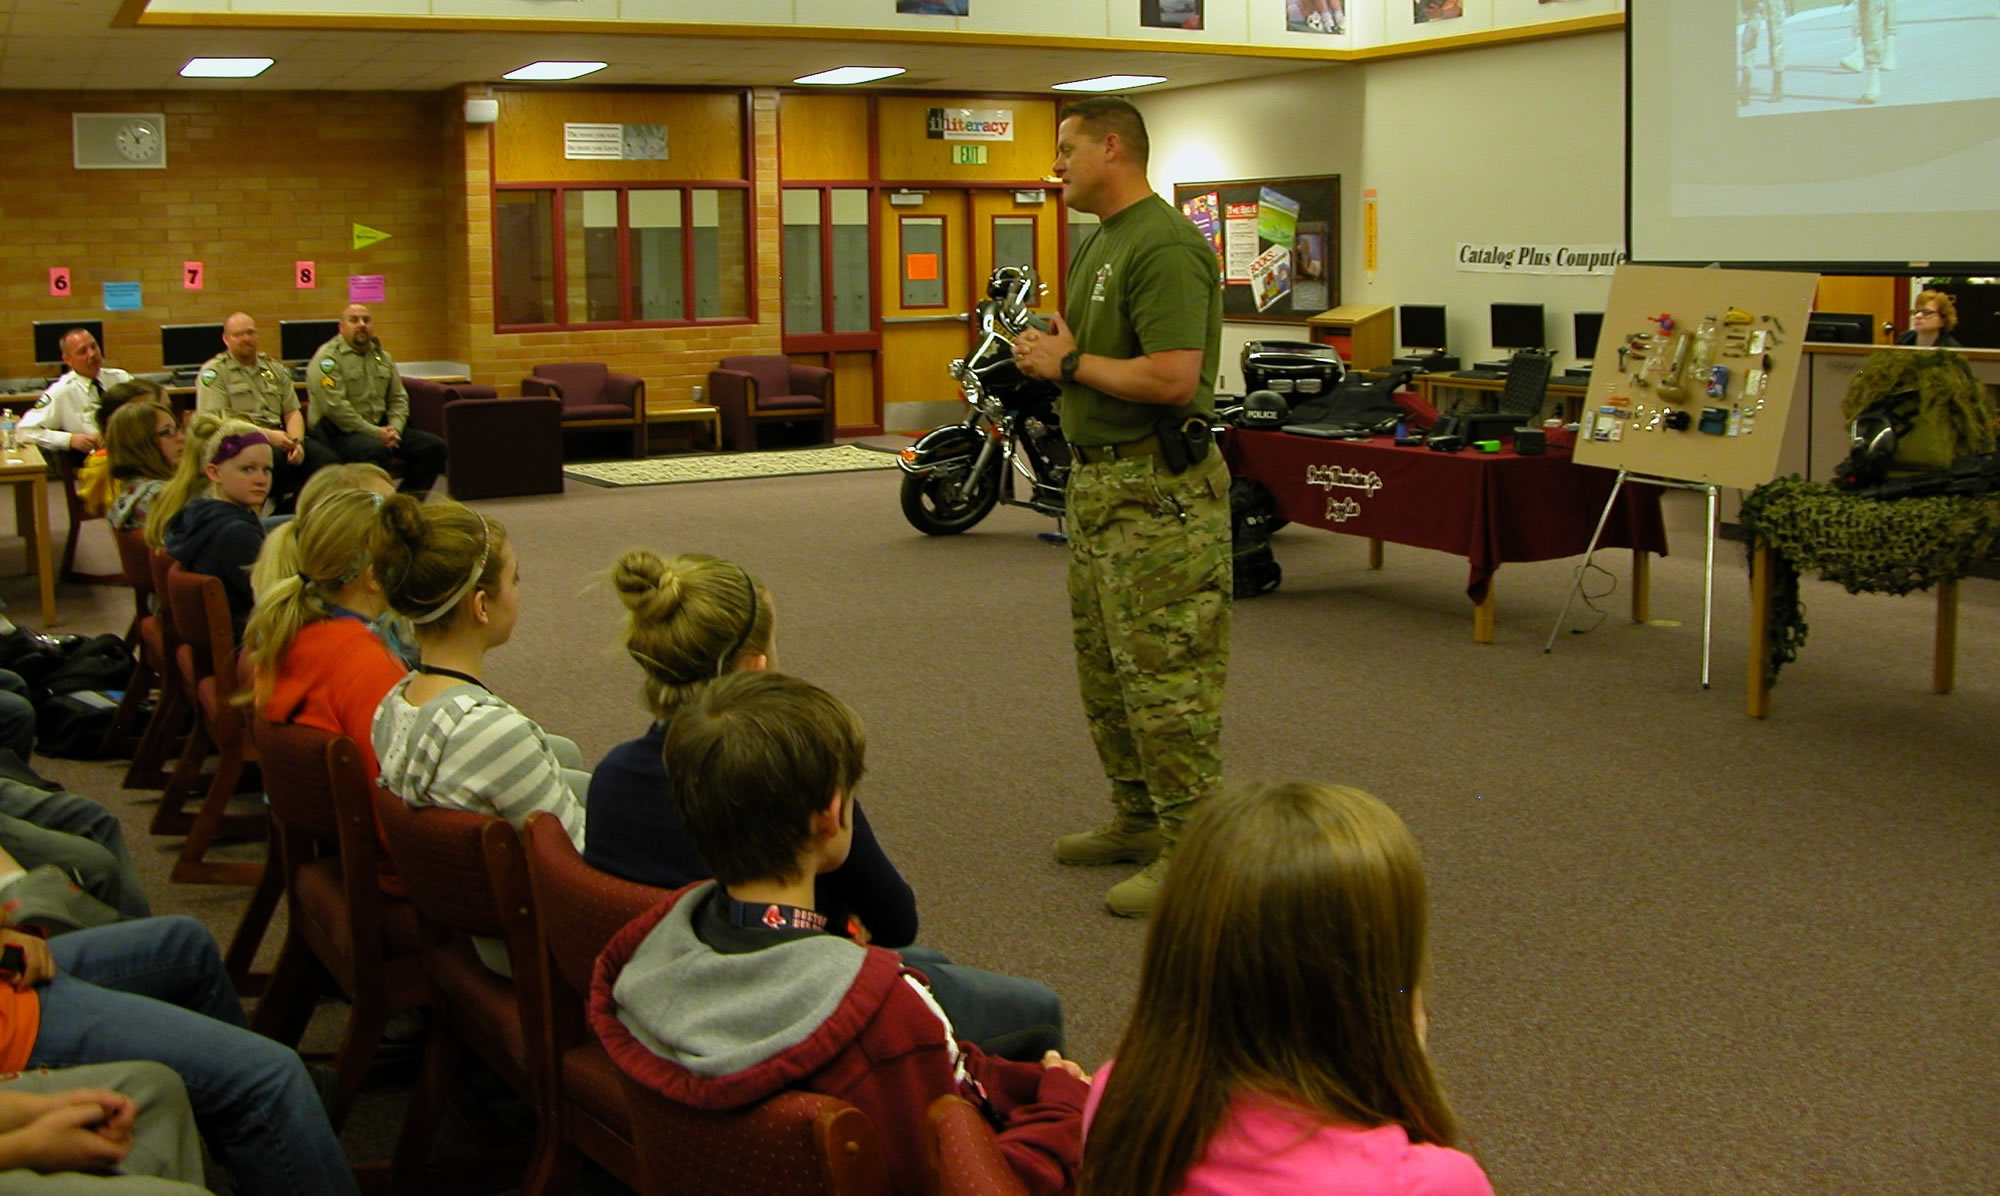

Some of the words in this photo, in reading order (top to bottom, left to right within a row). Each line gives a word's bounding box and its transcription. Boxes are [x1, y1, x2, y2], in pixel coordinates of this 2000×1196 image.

[961, 146, 979, 163] EXIT
[1459, 244, 1515, 269] Catalog
[1517, 246, 1552, 266] Plus
[54, 275, 67, 290] 6
[187, 269, 199, 284] 7
[300, 268, 312, 284] 8
[1246, 410, 1278, 420] POLICE
